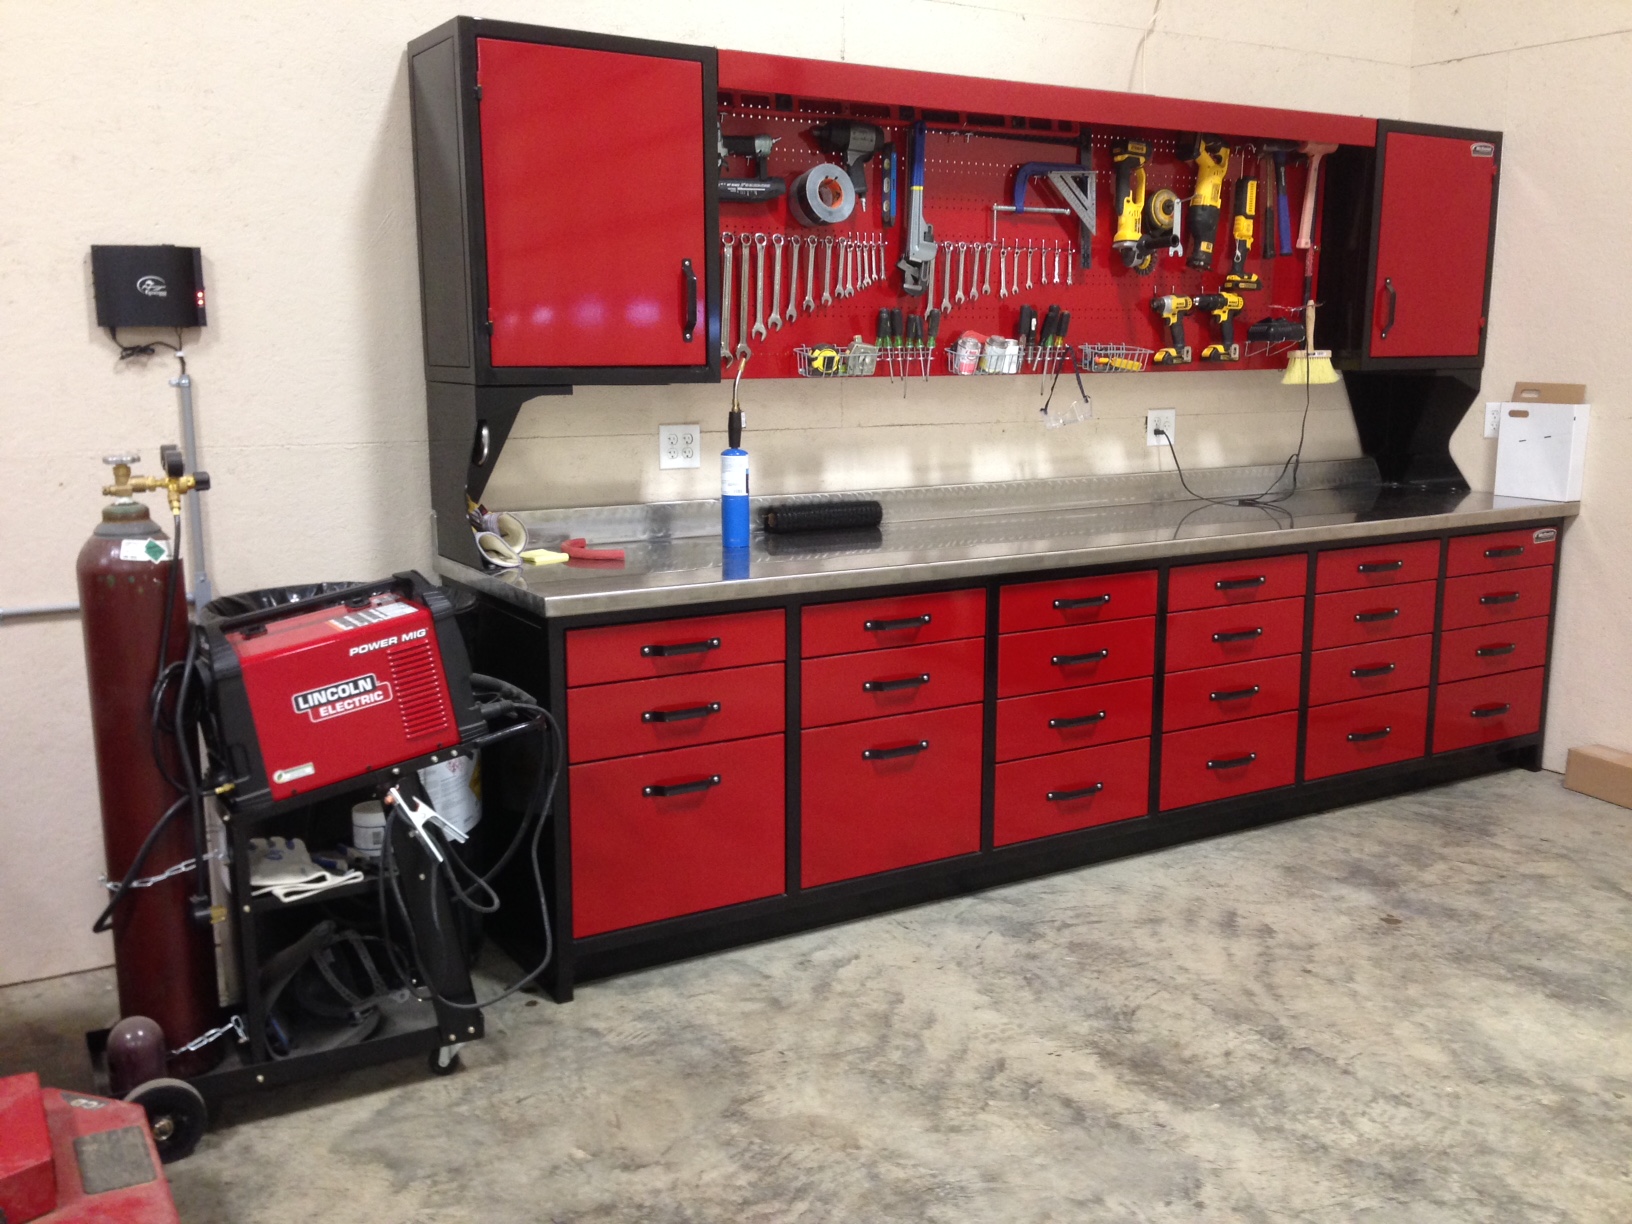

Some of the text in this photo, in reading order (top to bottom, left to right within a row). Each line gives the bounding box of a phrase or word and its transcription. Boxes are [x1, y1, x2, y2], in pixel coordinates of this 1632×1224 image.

[349, 628, 426, 657] POWER MIG
[297, 678, 373, 709] LINCOLN
[319, 690, 384, 717] ELECTRIC
